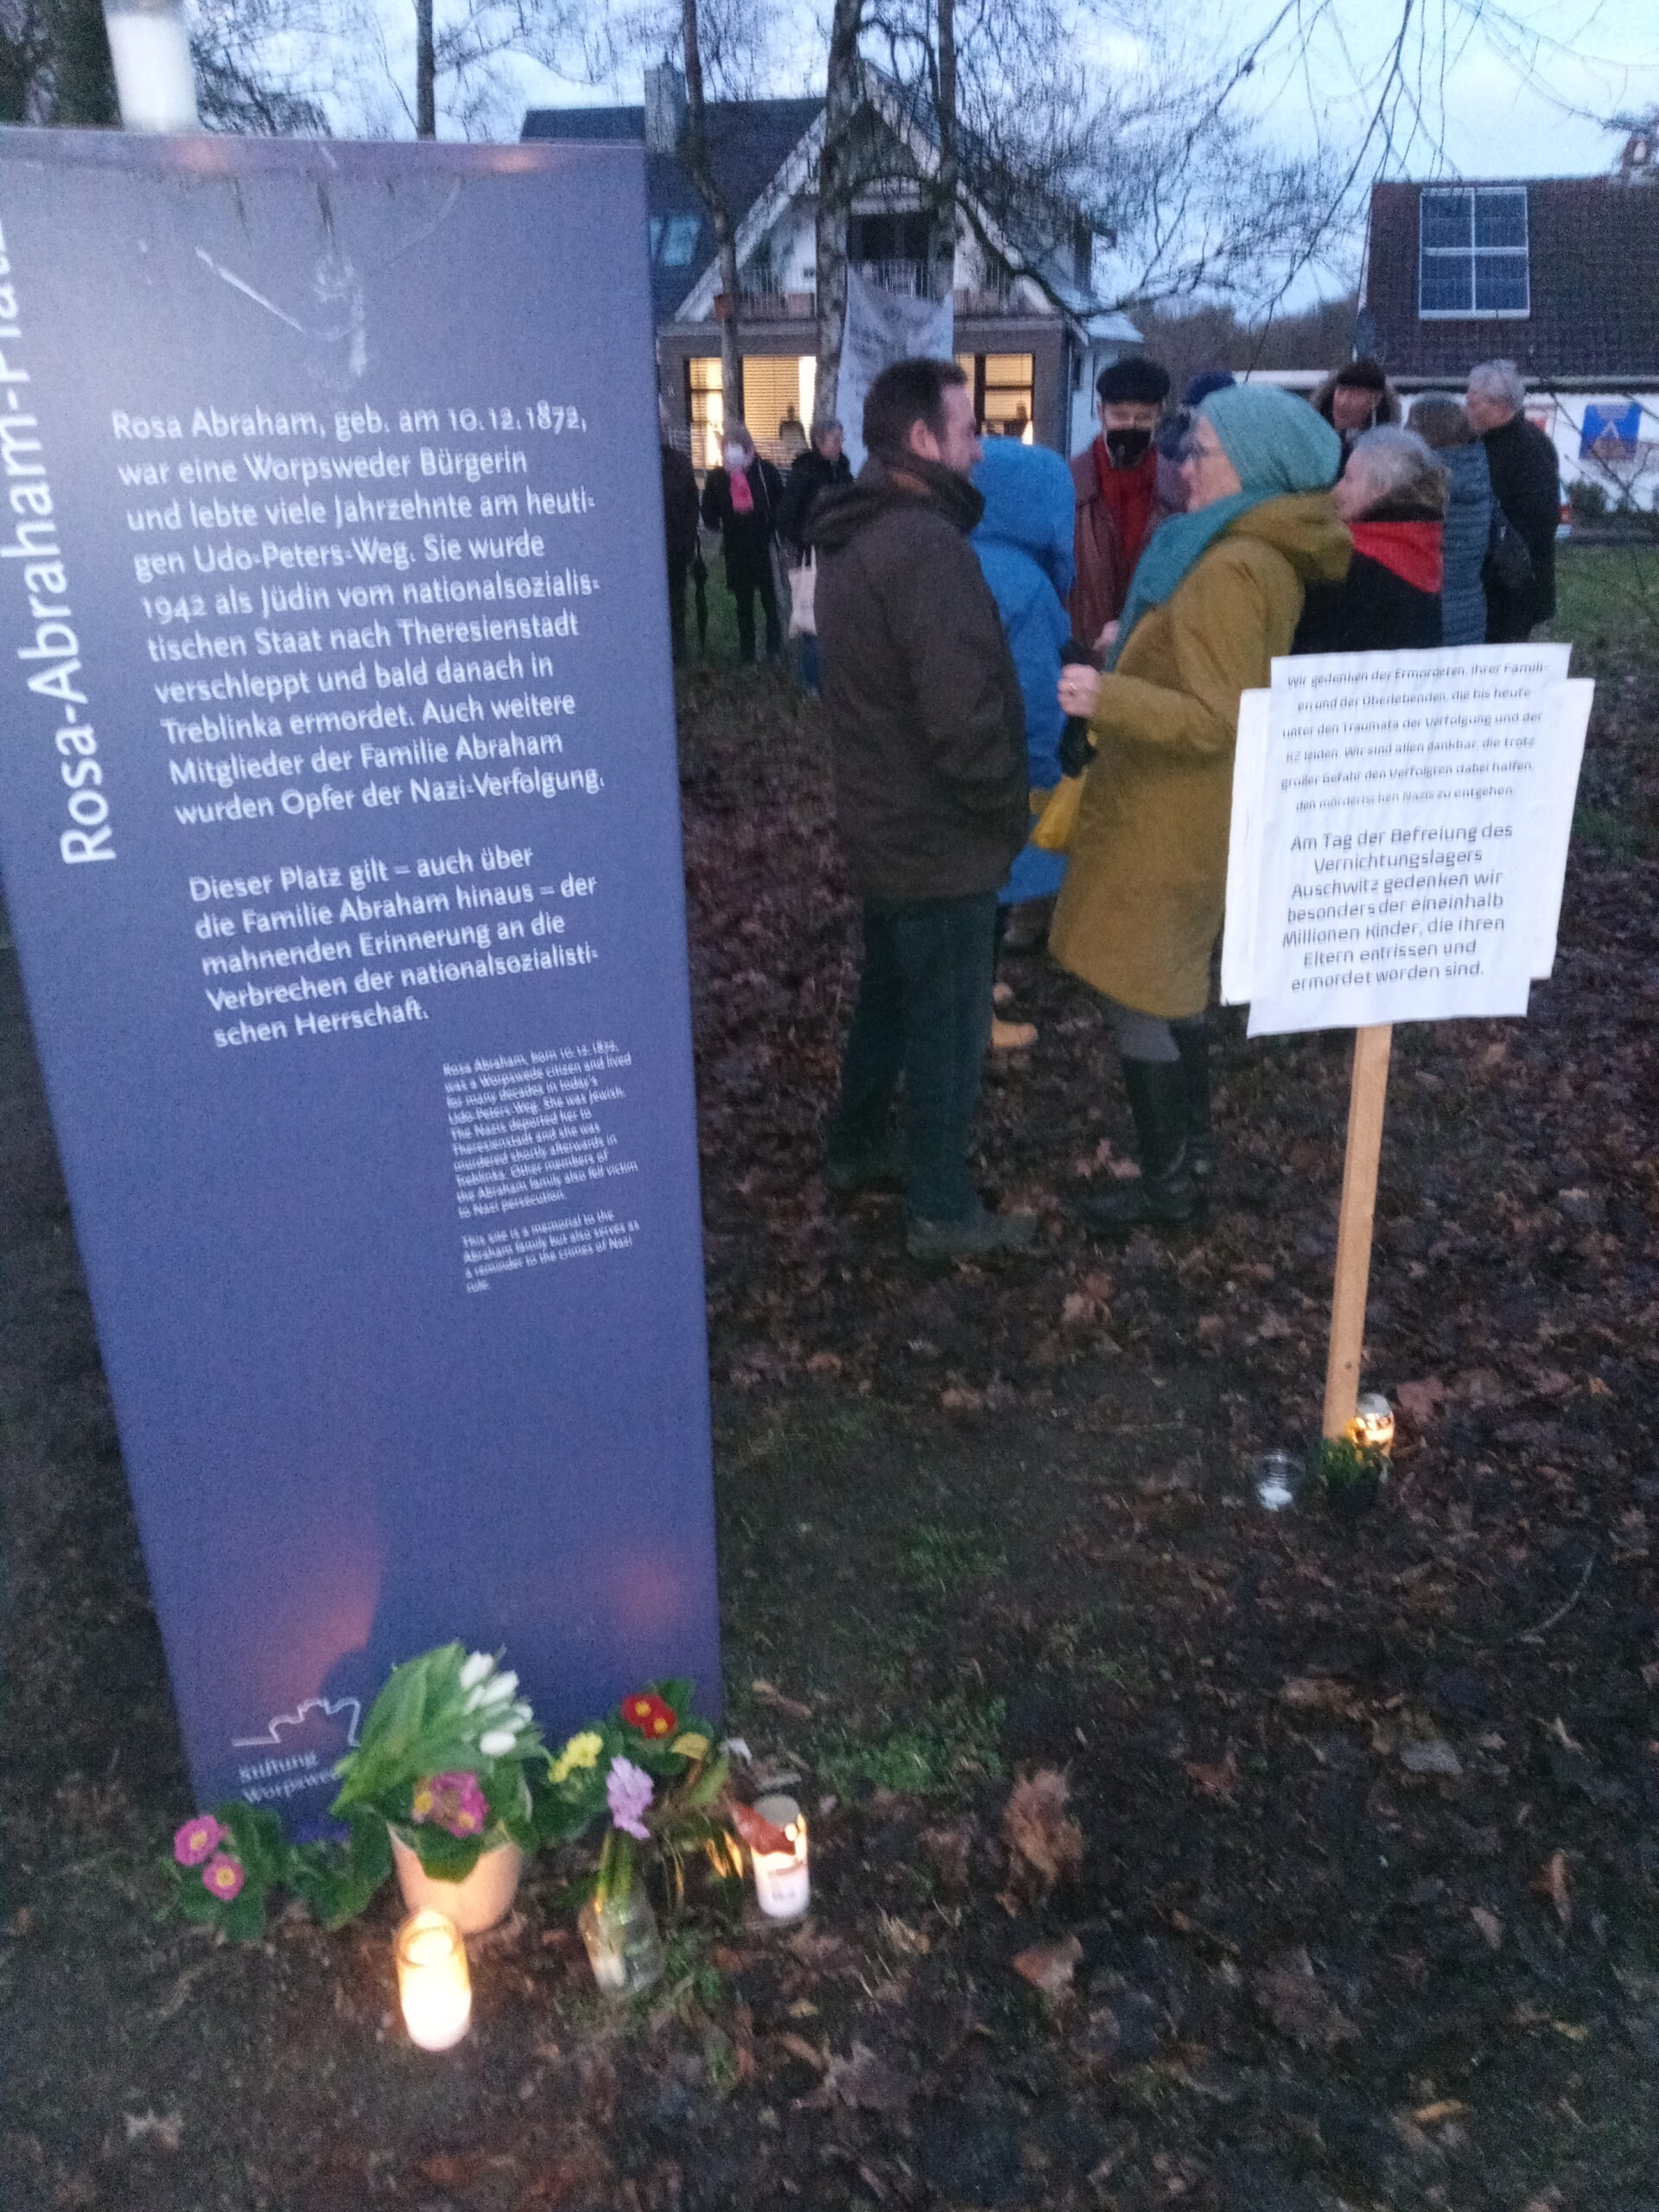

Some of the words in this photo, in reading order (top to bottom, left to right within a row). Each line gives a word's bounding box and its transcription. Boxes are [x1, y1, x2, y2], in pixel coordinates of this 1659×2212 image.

[111, 410, 183, 439] Rosa
[191, 406, 326, 437] Abraham,
[334, 404, 391, 442] geb.
[399, 409, 440, 433] am
[117, 463, 170, 486] war
[178, 460, 238, 484] eine
[243, 450, 411, 486] Worpsweder
[419, 447, 528, 482] Bürgerin
[126, 500, 182, 531] und
[189, 499, 257, 528] lebte
[264, 495, 327, 524] viele
[334, 493, 473, 527] Jahrzehnte
[480, 494, 518, 518] am
[133, 553, 186, 583] gen
[193, 538, 416, 572] Udo-Peters-Weg.
[423, 533, 462, 562] Sie
[467, 529, 545, 559] wurde
[141, 596, 207, 625] 1942
[215, 585, 253, 615] als
[261, 582, 330, 618] Jüdin
[336, 584, 395, 607] vom
[147, 632, 247, 662] tischen
[254, 628, 323, 655] Staat
[329, 620, 391, 650] nach
[397, 611, 580, 645] Theresienstadt
[154, 671, 311, 703] verschleppt
[317, 662, 367, 692] und
[374, 658, 429, 689] bald
[435, 653, 524, 683] danach
[531, 652, 554, 677] in
[159, 713, 283, 744] Treblinka
[289, 702, 415, 734] ermordet.
[422, 695, 485, 724] Auch
[490, 693, 576, 719] weitere
[168, 752, 304, 788] Mitglieder
[310, 746, 353, 772] der
[359, 739, 449, 768] Familie
[455, 732, 563, 760] Abraham
[174, 795, 274, 824] wurden
[280, 785, 355, 818] Opfer
[361, 781, 404, 808] der
[410, 768, 606, 802] Nazi-Verfolgung.
[1290, 836, 1318, 852] Am
[1323, 833, 1352, 850] Tag
[1357, 830, 1386, 846] der
[1390, 827, 1478, 843] Befreiung
[1481, 823, 1513, 838] des
[188, 875, 273, 901] Dieser
[279, 866, 342, 891] Platz
[348, 857, 390, 891] gilt
[416, 849, 474, 877] auch
[480, 845, 534, 871] über
[1314, 849, 1483, 873] Vernichtungslagers
[194, 913, 235, 939] die
[242, 903, 333, 932] Familie
[340, 893, 450, 921] Abraham
[455, 884, 535, 909] hinaus
[560, 873, 598, 898] der
[1291, 880, 1379, 899] Auschwitz
[1383, 874, 1469, 894] gedenken
[1473, 872, 1503, 886] wir
[1287, 903, 1376, 924] besonders
[1378, 899, 1405, 914] der
[1410, 893, 1504, 912] eineinhalb
[201, 939, 353, 975] mahnenden
[359, 925, 492, 957] Erinnerung
[497, 920, 524, 940] an
[531, 911, 566, 936] die
[1281, 928, 1360, 948] Millionen
[1365, 920, 1422, 938] Kinder,
[1427, 918, 1453, 933] die
[1459, 917, 1505, 931] ihren
[1303, 950, 1354, 968] Eltern
[1359, 944, 1438, 961] entrissen
[1443, 938, 1477, 956] und
[205, 977, 347, 1010] Verbrechen
[353, 969, 394, 993] der
[1291, 970, 1371, 991] ermordet
[1376, 965, 1440, 983] worden
[1445, 961, 1484, 976] sind.
[213, 1021, 288, 1047] schen
[295, 997, 429, 1034] Herrschaft.
